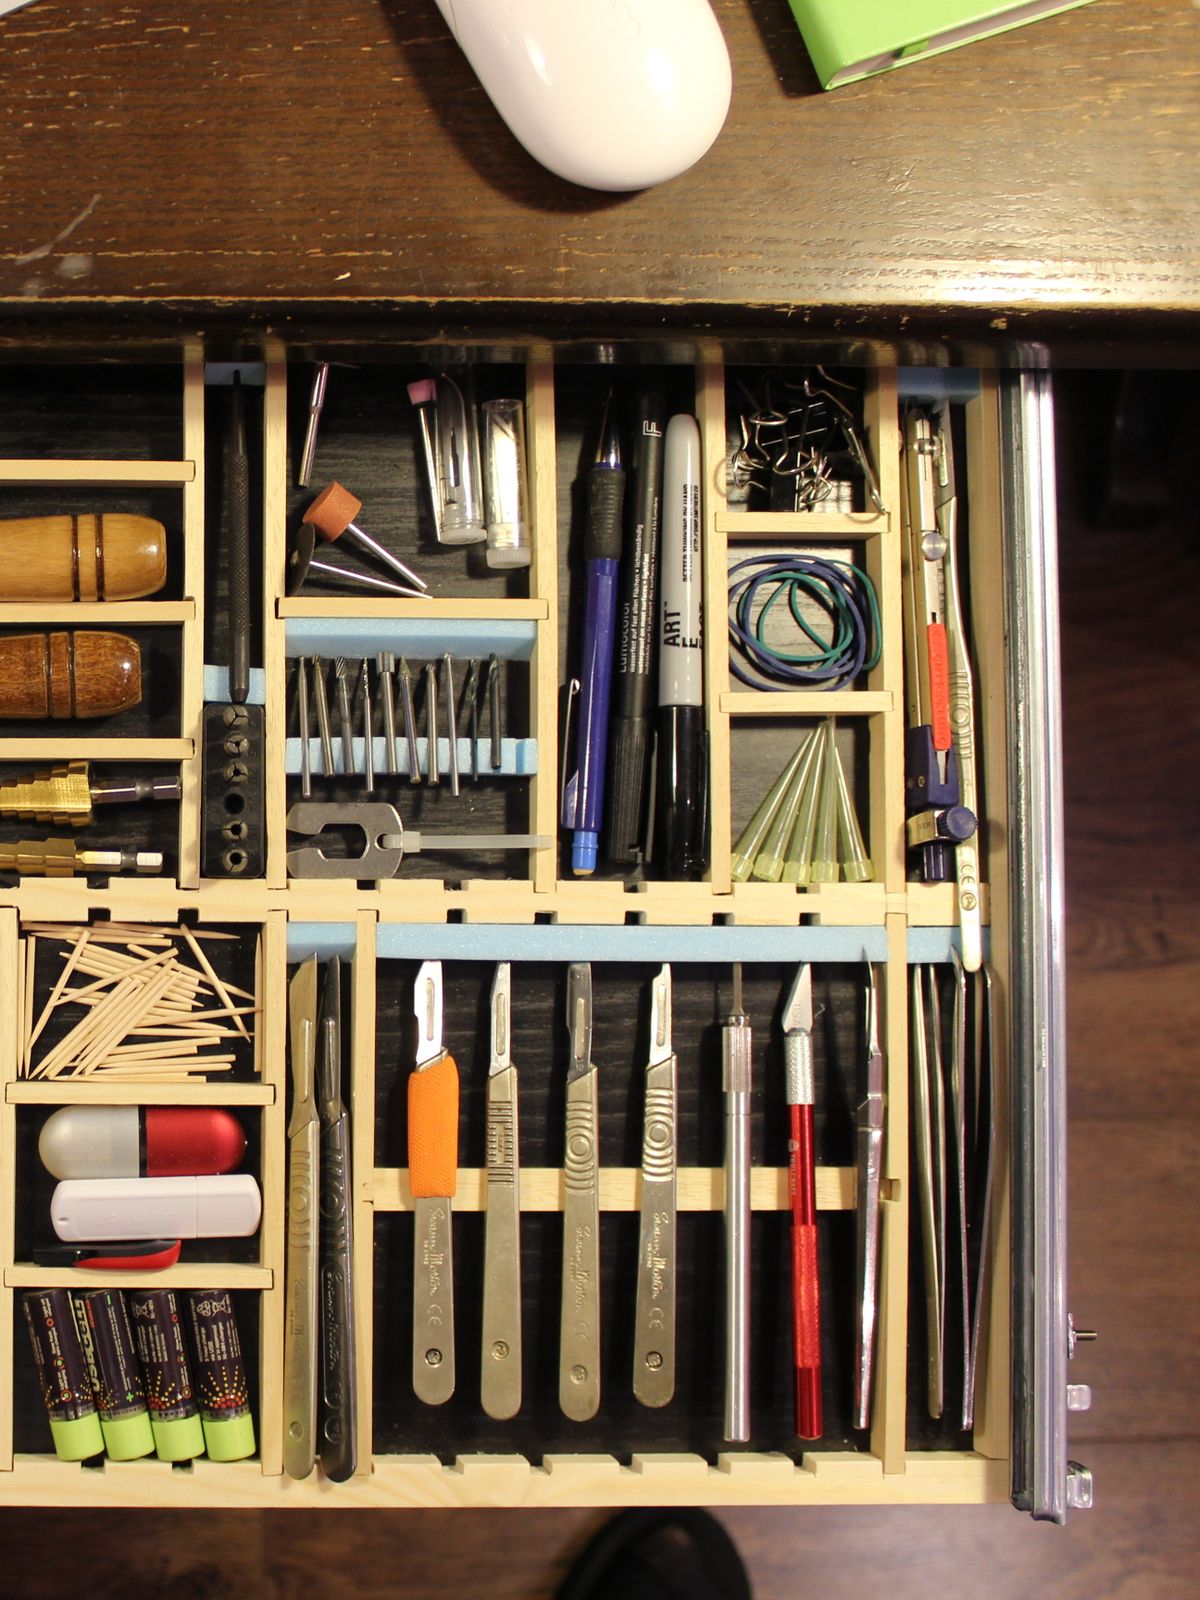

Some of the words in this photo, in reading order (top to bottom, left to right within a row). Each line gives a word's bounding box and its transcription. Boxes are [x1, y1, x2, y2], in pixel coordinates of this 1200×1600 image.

[640, 628, 645, 637] on
[425, 1303, 443, 1327] CE
[647, 1307, 665, 1330] CE
